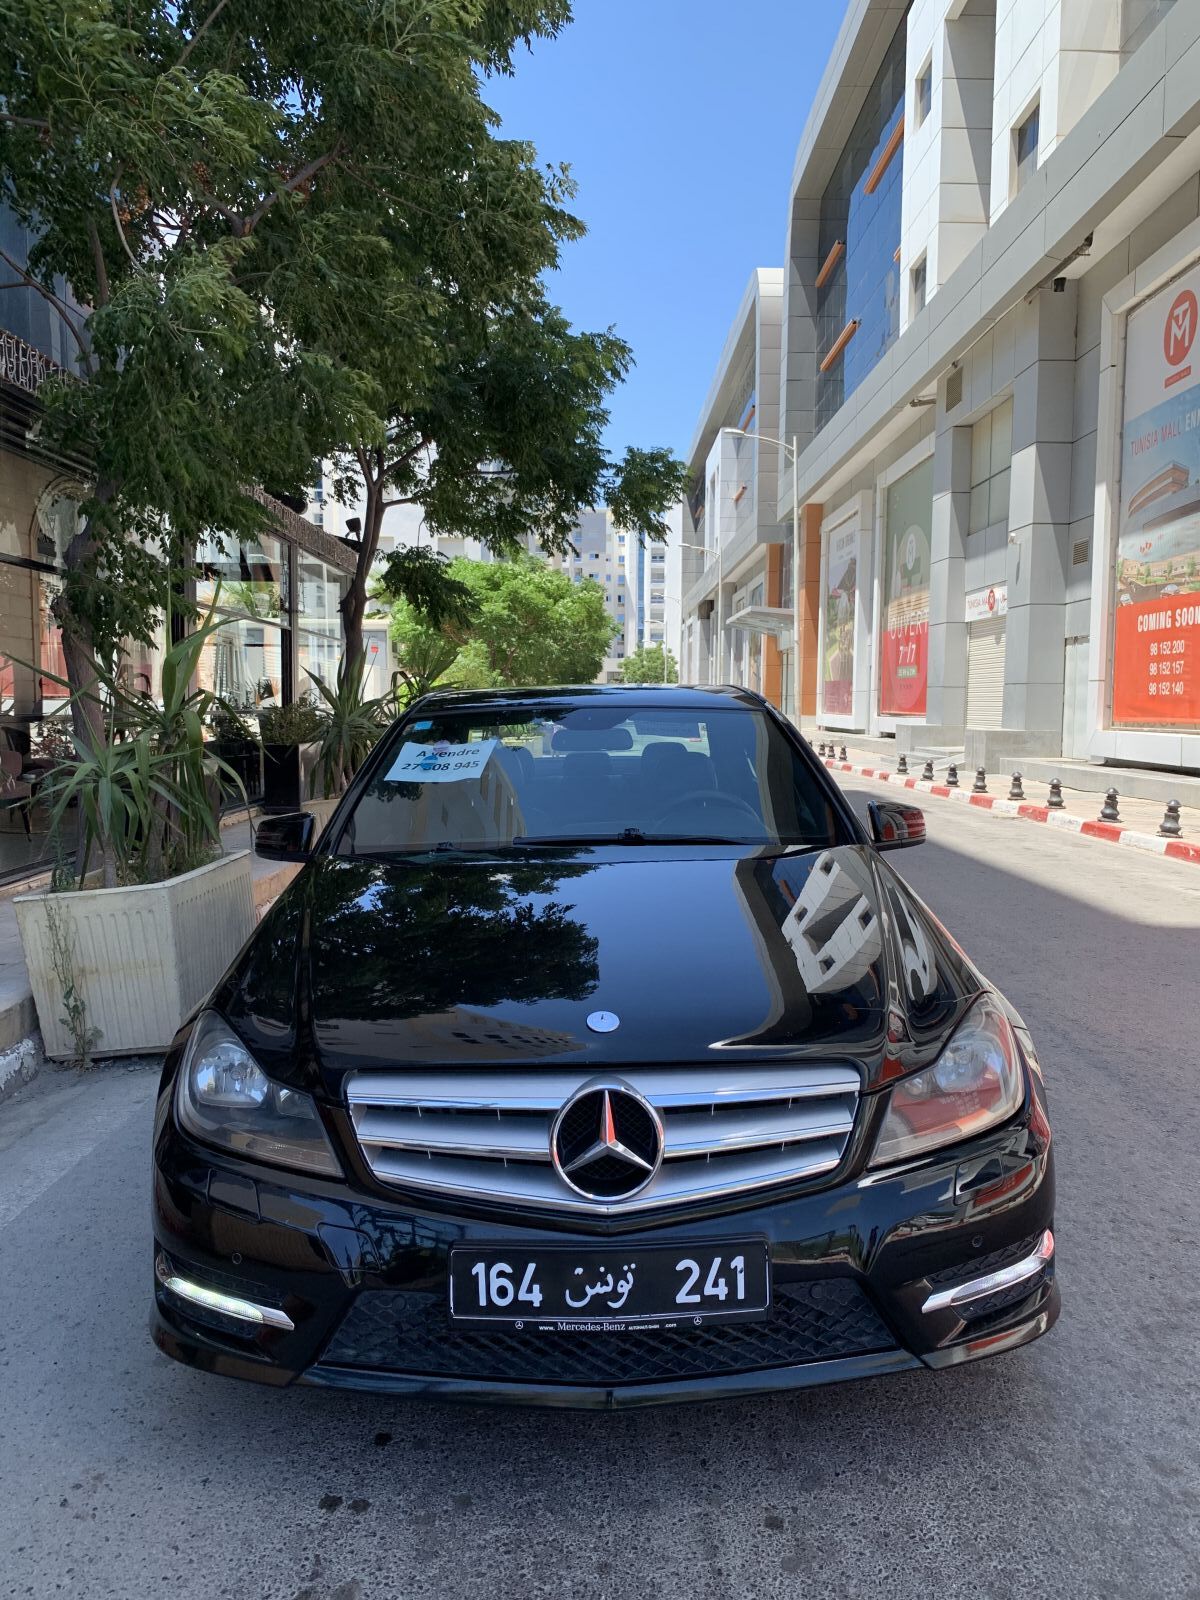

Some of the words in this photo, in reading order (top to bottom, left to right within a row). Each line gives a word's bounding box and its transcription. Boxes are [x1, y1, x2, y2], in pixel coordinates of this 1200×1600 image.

[1131, 429, 1158, 456] TUNISIA
[1161, 415, 1183, 442] MALL
[1137, 611, 1172, 632] COMING
[1150, 643, 1158, 656] 98
[1160, 641, 1171, 654] 152
[1172, 640, 1185, 653] 200
[1149, 663, 1158, 675] 98
[1159, 661, 1171, 674] 152
[1172, 661, 1184, 674] 157
[1148, 683, 1157, 695] 98
[1158, 682, 1170, 694] 152
[1171, 681, 1184, 694] 140
[432, 748, 479, 757] vendre
[453, 760, 479, 770] 945
[471, 1262, 543, 1308] 164
[565, 1263, 637, 1309] تونس
[675, 1255, 745, 1304] 241
[557, 1321, 626, 1331] Mercedes-Benz
